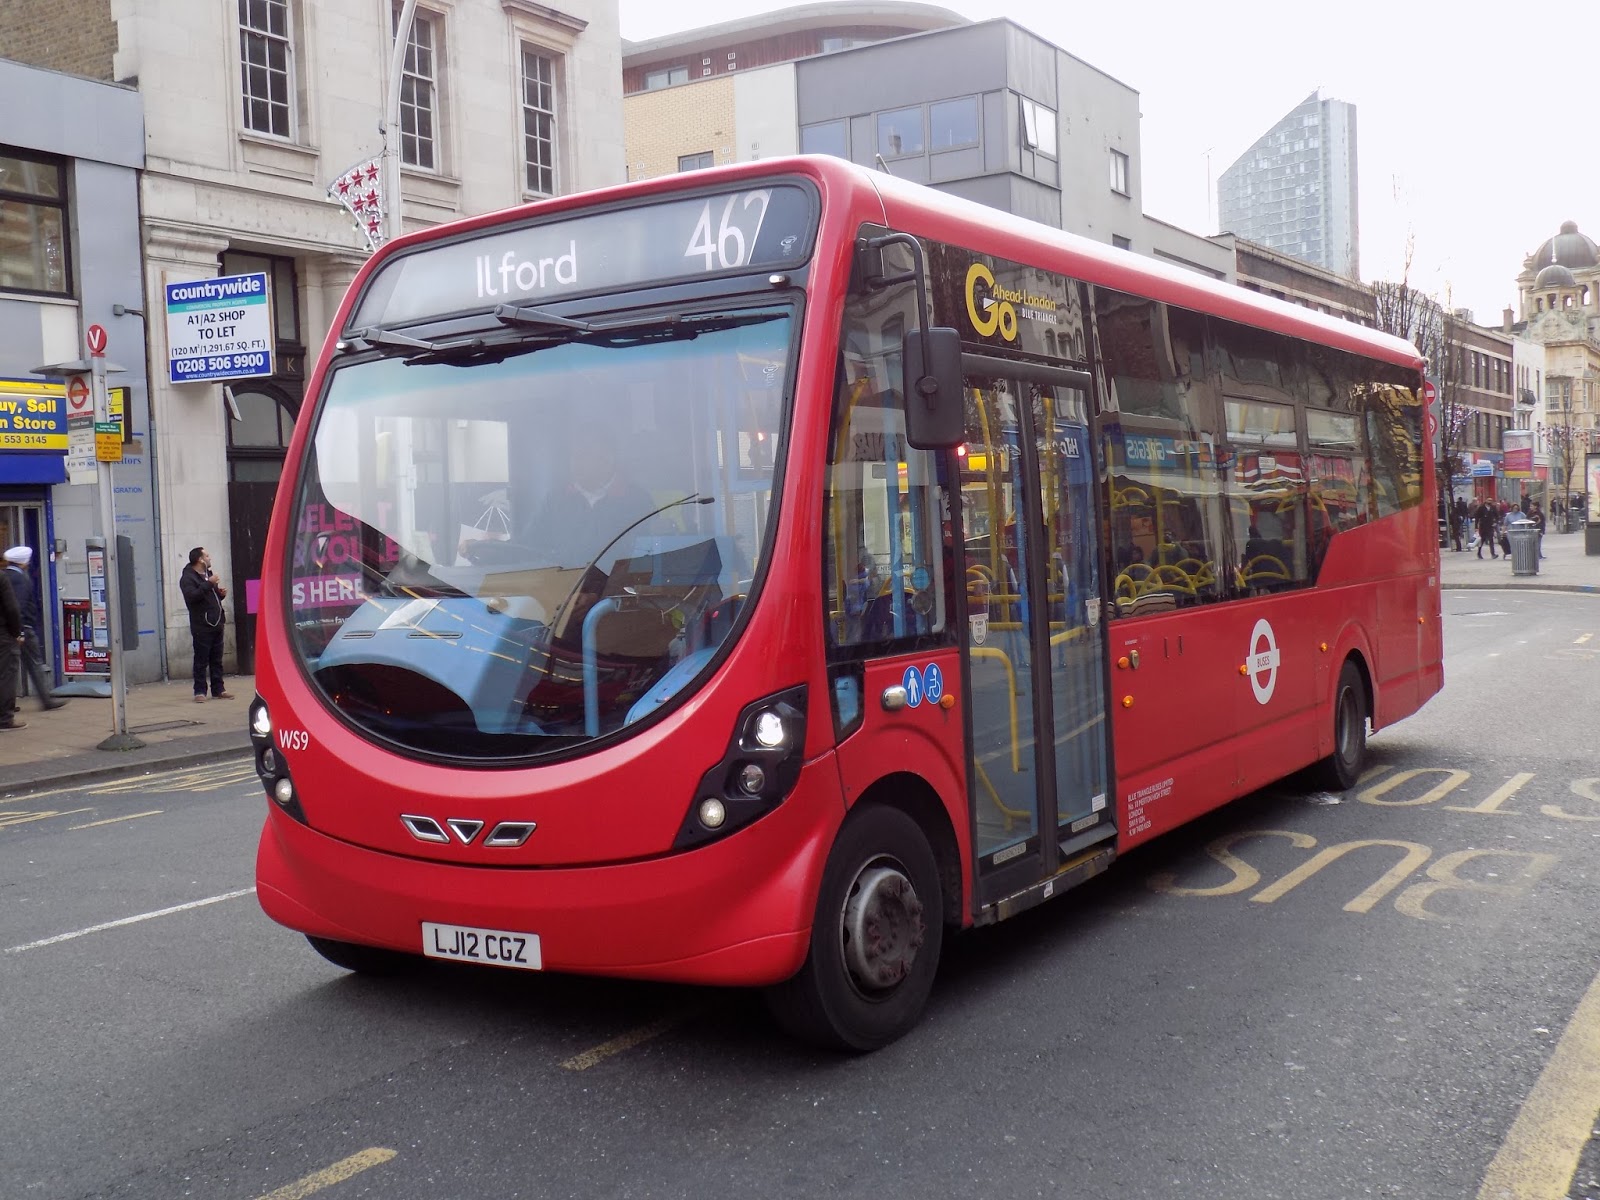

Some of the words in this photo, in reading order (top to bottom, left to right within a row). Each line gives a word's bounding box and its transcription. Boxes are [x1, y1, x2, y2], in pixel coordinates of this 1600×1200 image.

[683, 188, 772, 271] 467
[476, 240, 578, 297] Ilford
[172, 277, 260, 300] countrywide
[993, 284, 1056, 311] Ahead-London
[966, 263, 1017, 341] Go
[187, 313, 216, 326] A1/A2
[218, 310, 246, 322] SHOP
[1022, 307, 1034, 319] BLUE
[1035, 310, 1057, 324] TRIANGLE
[89, 329, 100, 349] V
[198, 328, 214, 340] TO
[217, 326, 236, 338] LET
[172, 347, 188, 358] (120
[236, 342, 250, 351] SQ.
[252, 340, 266, 350] FT.)
[176, 359, 206, 374] 0208
[208, 357, 232, 370] 506
[234, 354, 264, 367] 9900
[186, 368, 256, 379] www.countrywidecomm.co.uk
[27, 398, 56, 413] Sell
[13, 416, 56, 430] Store
[4, 436, 22, 444] 553
[24, 436, 47, 444] 3145
[1257, 656, 1270, 668] BUSES
[279, 729, 308, 750] WS9
[1128, 793, 1136, 802] BLUE
[1137, 787, 1152, 797] TRIANGLE
[1152, 783, 1161, 792] BUSES
[1162, 778, 1174, 788] LIMITED
[1160, 787, 1171, 797] STREET
[1128, 808, 1143, 819] LONDON
[1147, 829, 1560, 921] BUS
[434, 928, 479, 958] LJ12
[485, 934, 528, 963] CGZ
